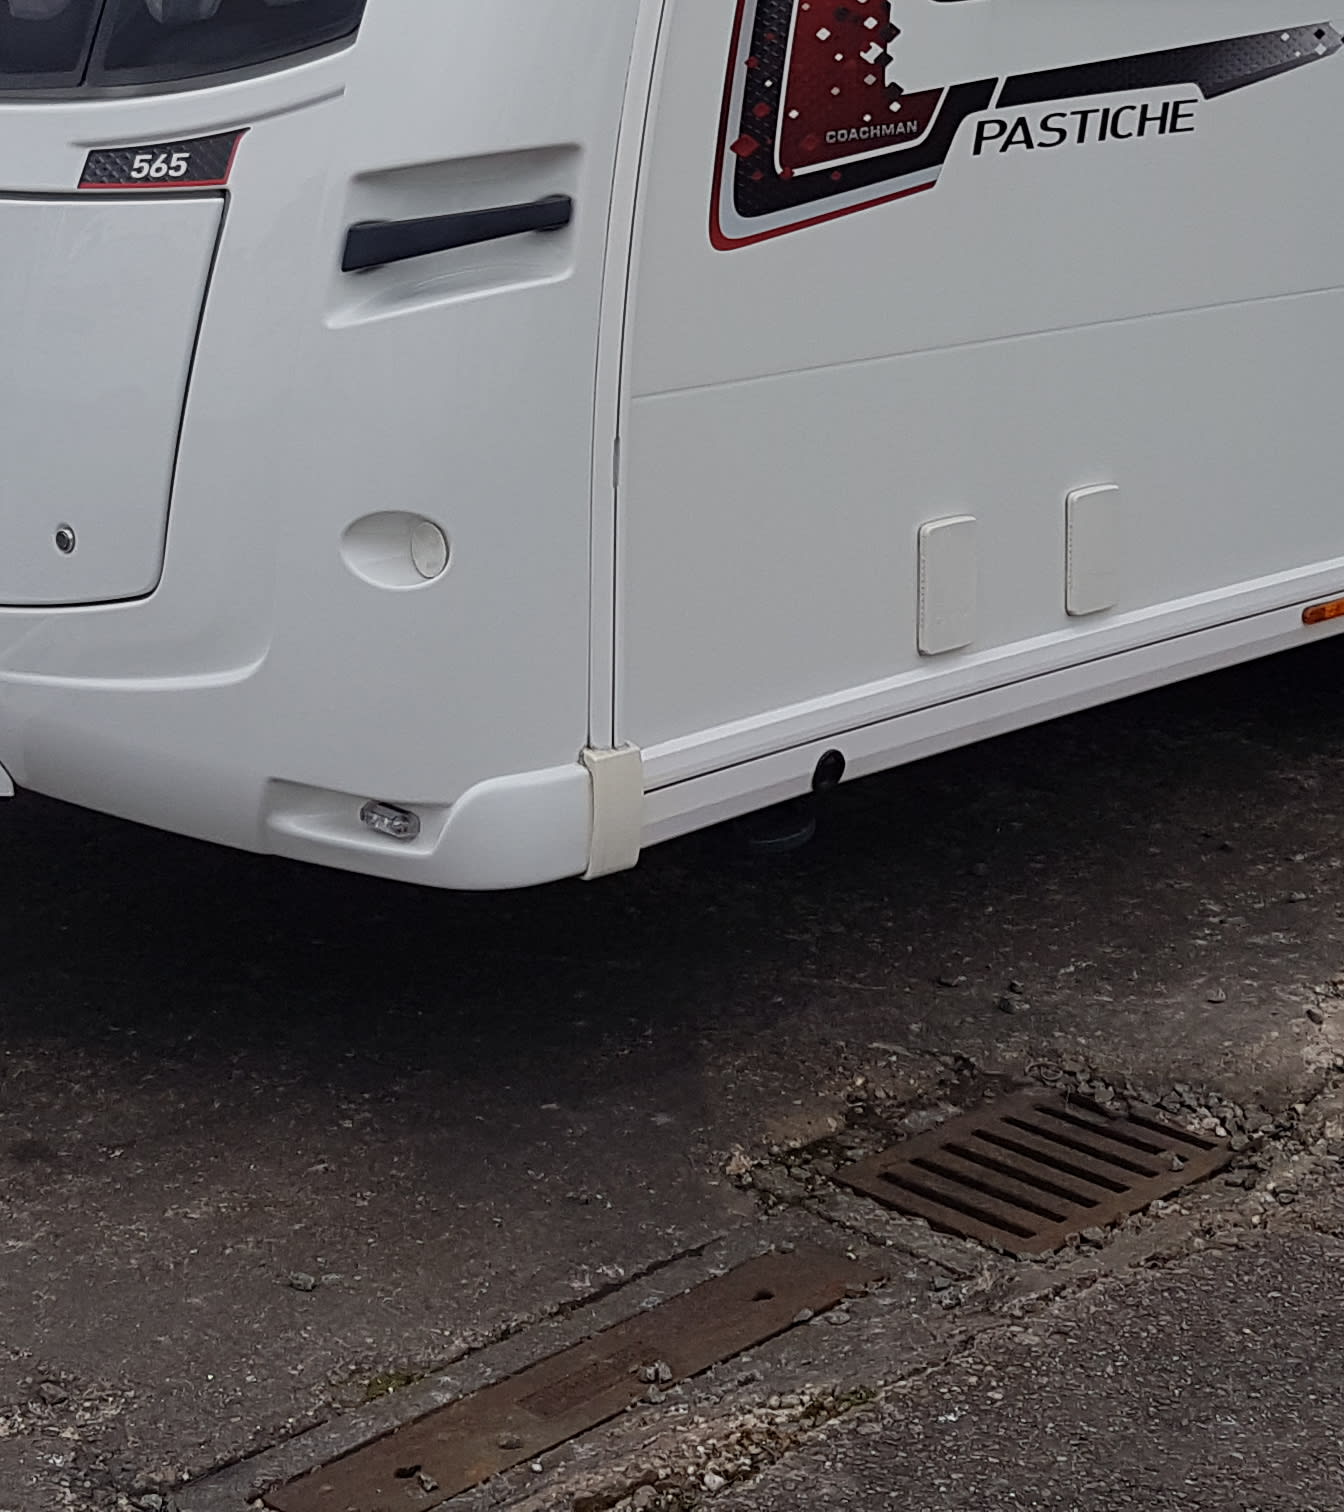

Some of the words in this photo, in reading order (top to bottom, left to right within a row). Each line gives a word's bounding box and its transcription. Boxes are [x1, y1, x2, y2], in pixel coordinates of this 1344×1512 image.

[826, 120, 918, 143] COACHMAN
[972, 99, 1200, 156] PASTICHE
[130, 152, 189, 179] 565
